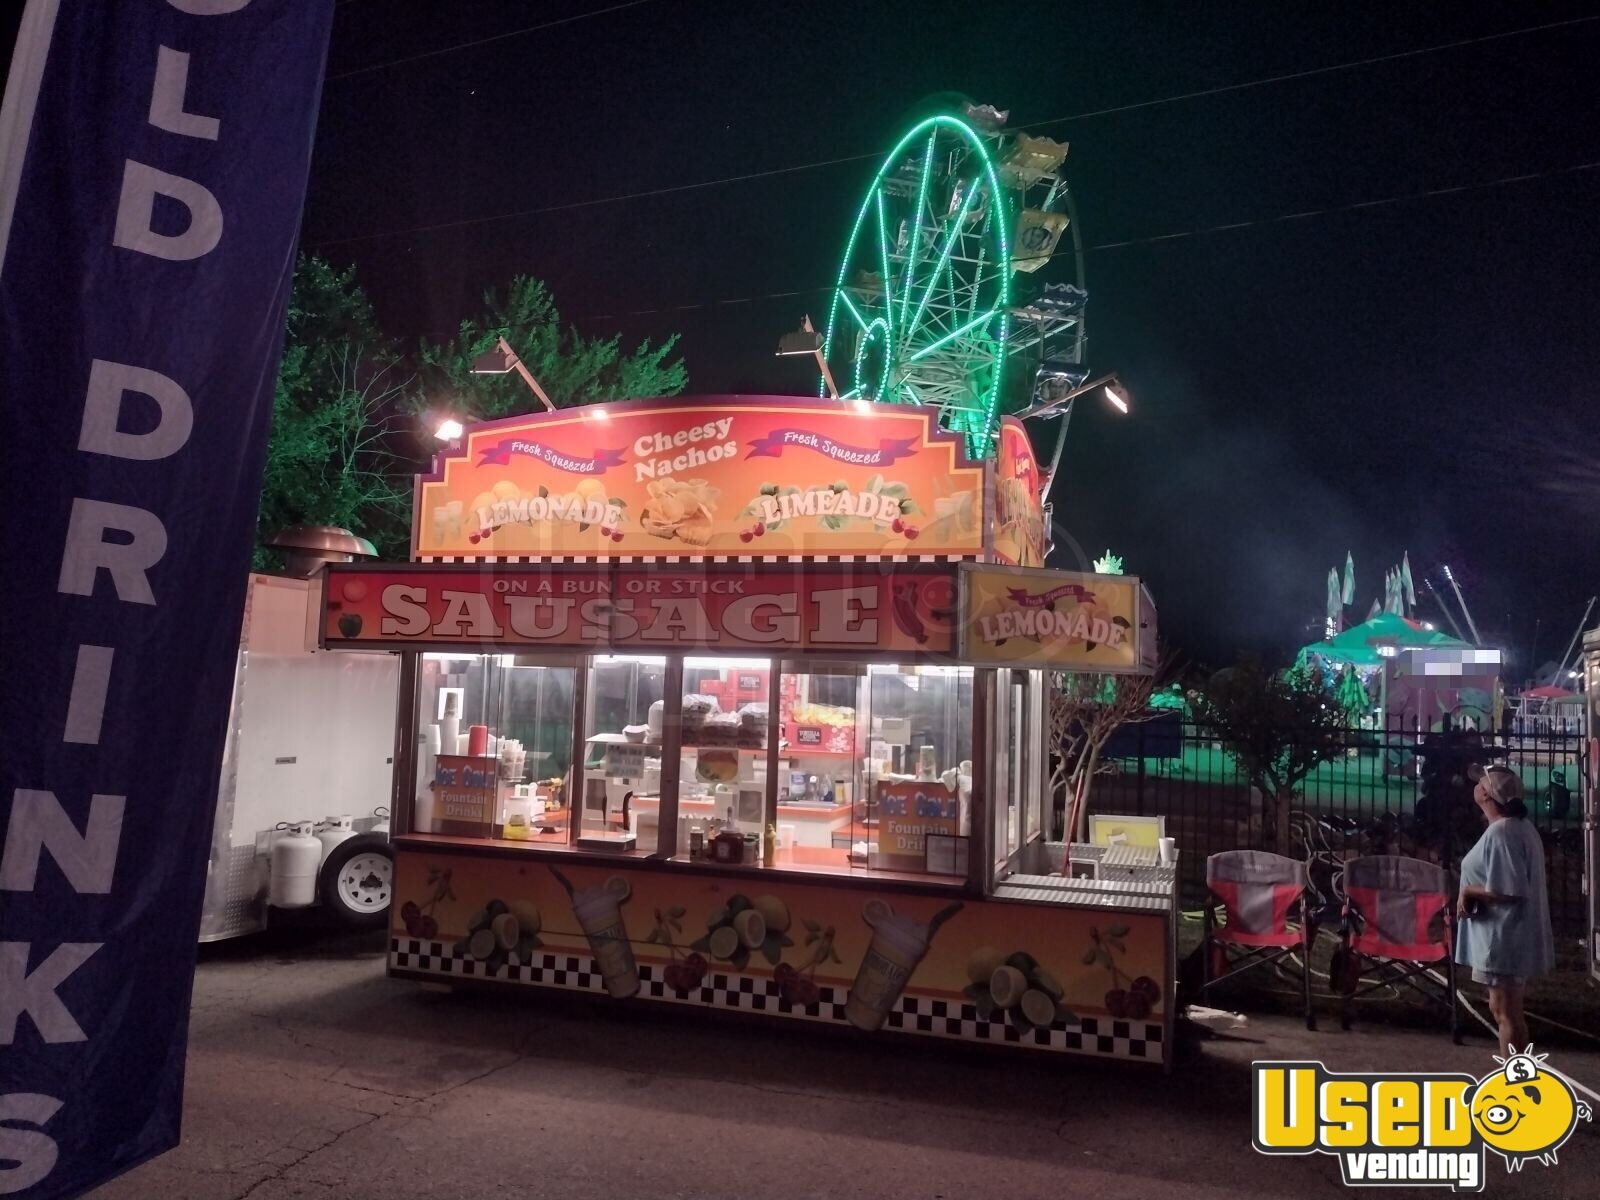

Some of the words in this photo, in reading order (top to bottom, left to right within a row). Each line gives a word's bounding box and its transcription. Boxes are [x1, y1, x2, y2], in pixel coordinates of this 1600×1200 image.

[112, 0, 254, 262] LD
[633, 416, 734, 457] Cheesy
[783, 431, 819, 448] Fresh
[821, 440, 881, 464] Squeezed
[510, 441, 542, 457] Fresh
[544, 449, 596, 473] Squeezed
[633, 440, 738, 482] Nachos
[476, 495, 623, 530] LEMONADE
[760, 489, 902, 525] LIMEADE
[492, 579, 528, 593] ON
[536, 579, 552, 593] A
[562, 580, 612, 594] BUN
[626, 580, 662, 594] OR
[671, 580, 745, 594] STICK
[381, 583, 878, 644] SAUSAGE
[979, 609, 1126, 649] LEMONADE
[887, 820, 949, 835] Fountain
